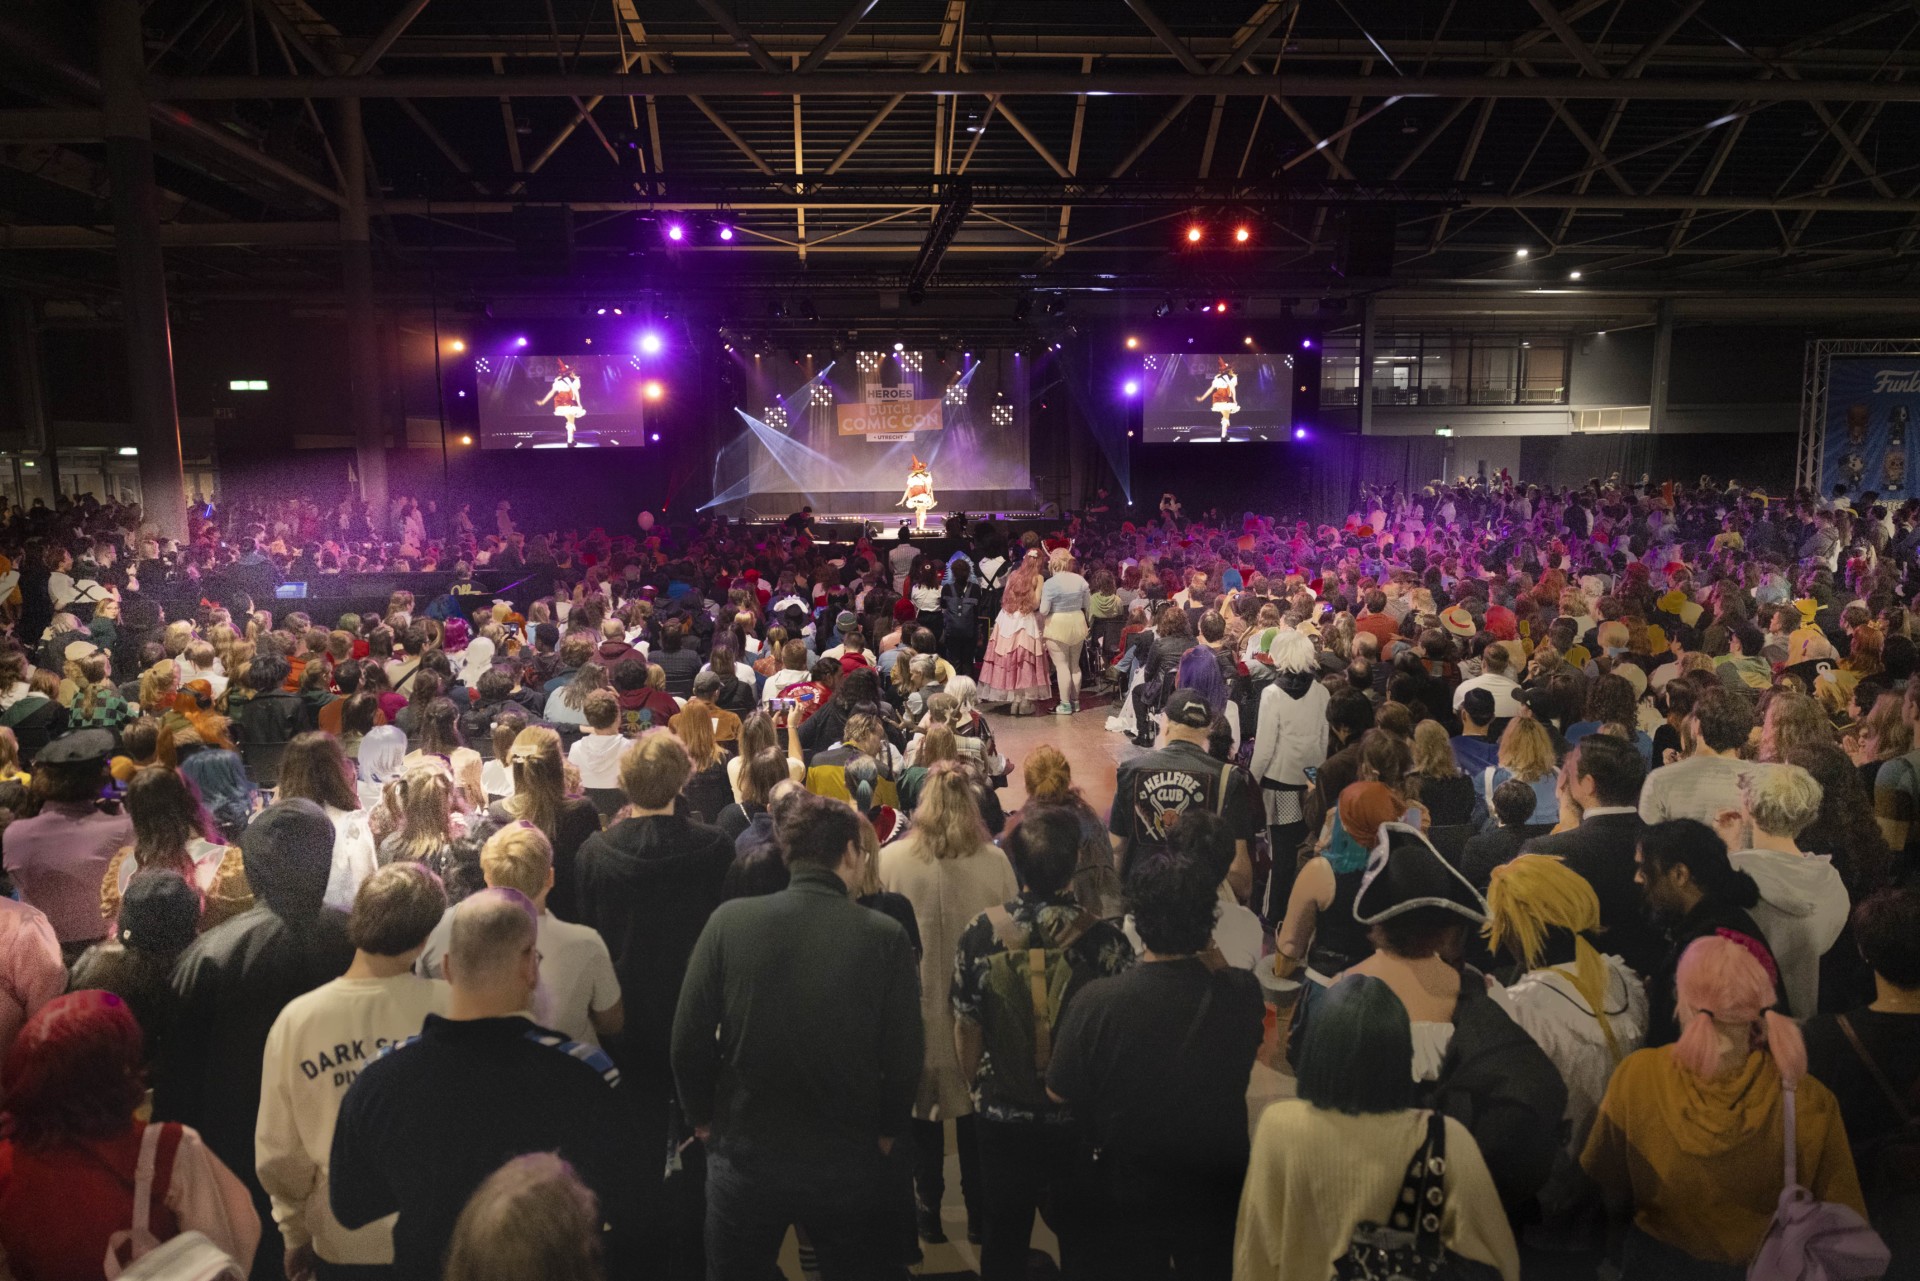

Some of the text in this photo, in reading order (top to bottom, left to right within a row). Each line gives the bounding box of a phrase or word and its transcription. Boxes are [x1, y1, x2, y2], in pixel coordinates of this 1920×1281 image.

[867, 389, 913, 399] HEROES
[869, 404, 911, 416] DUTCH
[842, 413, 939, 431] COMIC CON
[1143, 771, 1201, 795] HELLFIRE
[1156, 788, 1184, 802] CLUB
[300, 1039, 367, 1080] DARK
